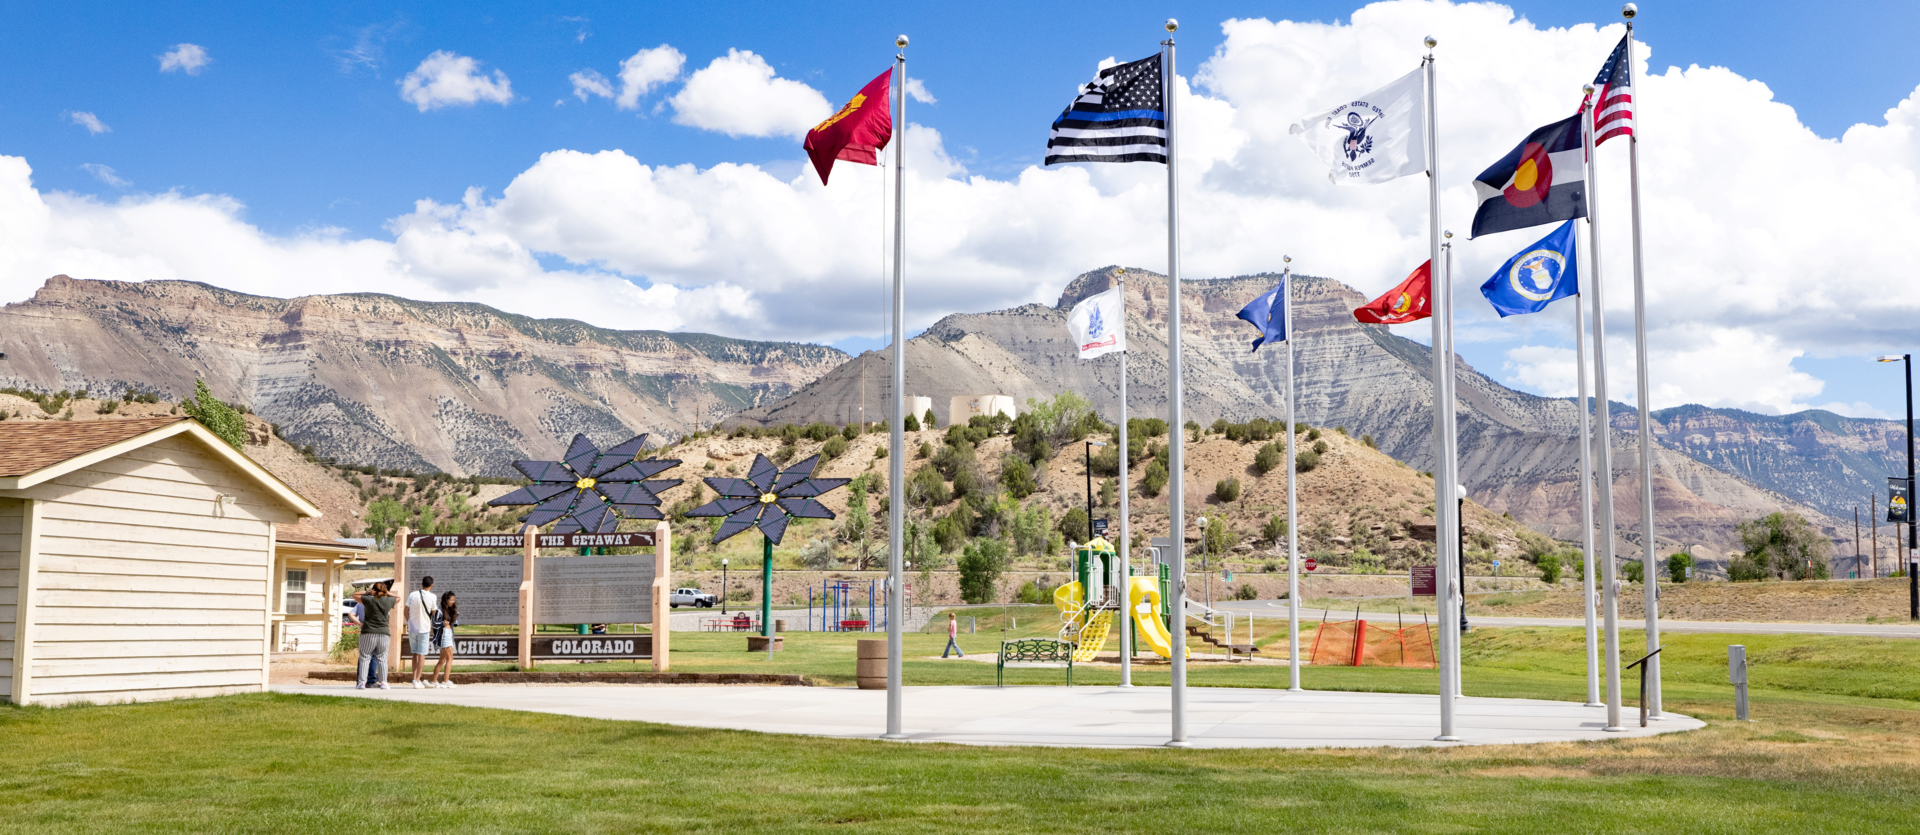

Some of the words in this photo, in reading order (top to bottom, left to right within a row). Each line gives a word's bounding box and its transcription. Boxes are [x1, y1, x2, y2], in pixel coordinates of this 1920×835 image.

[434, 536, 459, 546] THE
[465, 536, 524, 546] ROBBERY
[540, 535, 565, 546] THE
[571, 534, 632, 546] GETAWAY
[428, 641, 508, 654] ACHUTE
[552, 640, 634, 654] COLORADO
